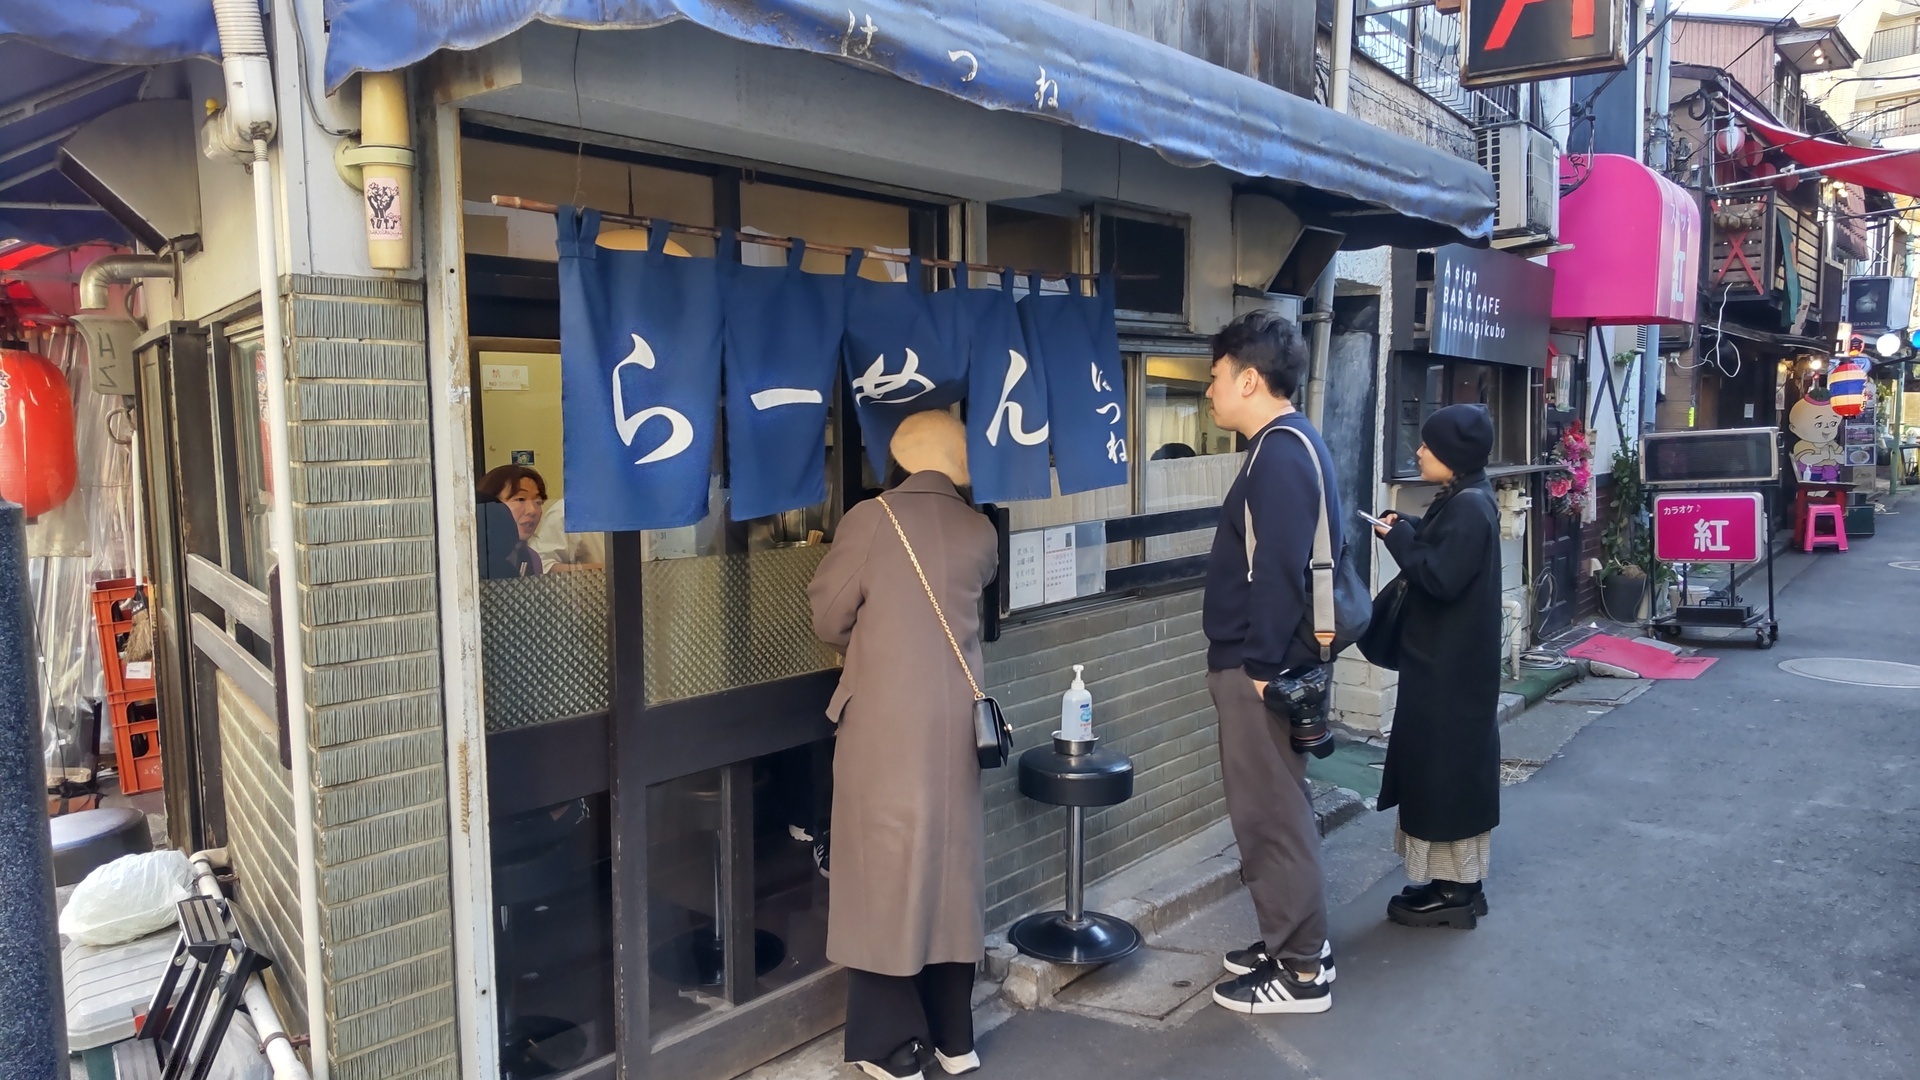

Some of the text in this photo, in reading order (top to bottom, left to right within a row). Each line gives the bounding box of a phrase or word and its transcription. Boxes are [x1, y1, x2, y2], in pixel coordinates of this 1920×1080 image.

[1444, 258, 1477, 287] A sign
[1443, 286, 1500, 315] BAR & CAFE
[1442, 311, 1505, 340] Nishiogikubo
[1663, 505, 1694, 516] カラオケ
[1693, 518, 1730, 552] 紅
